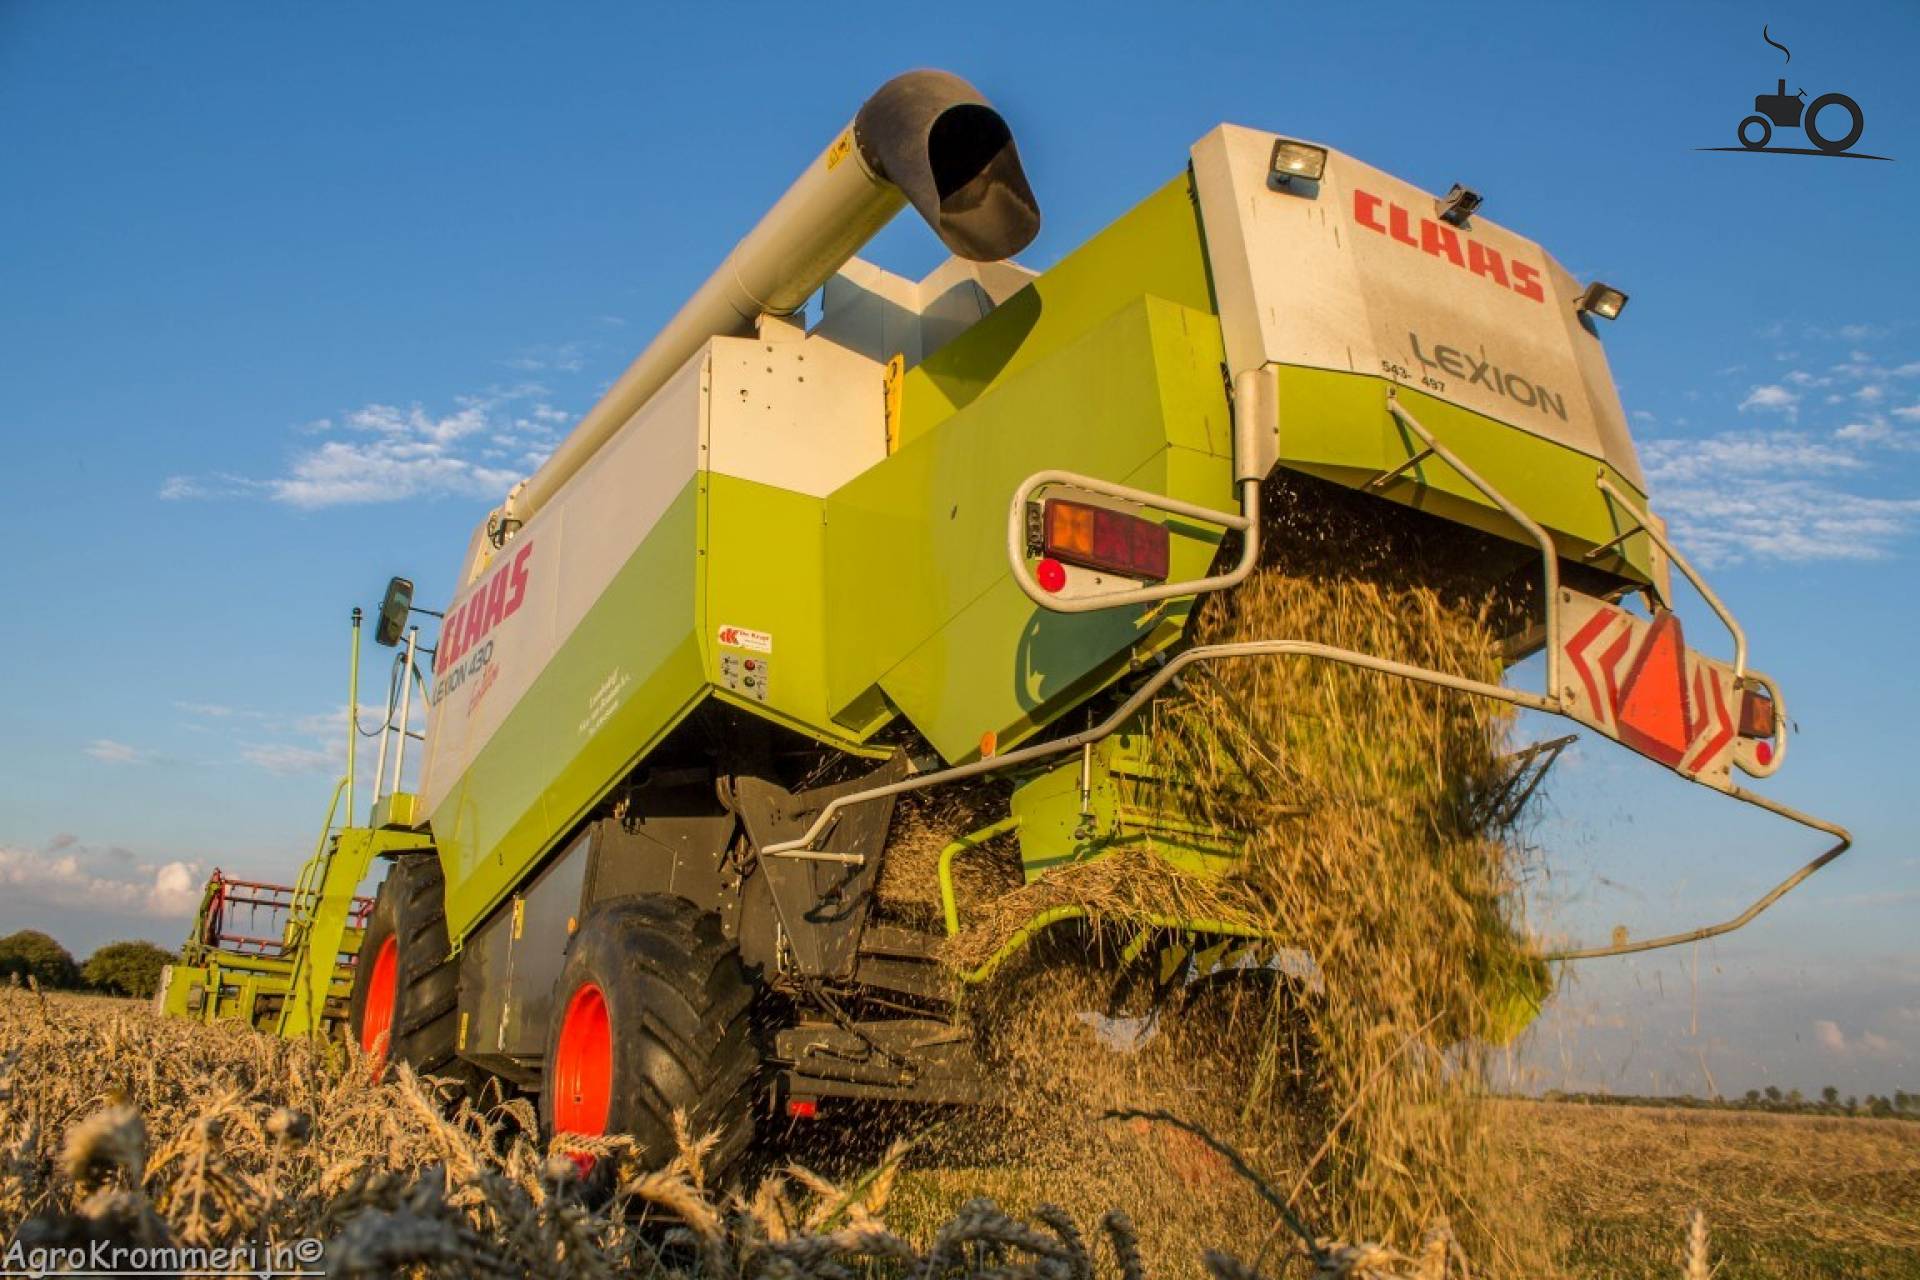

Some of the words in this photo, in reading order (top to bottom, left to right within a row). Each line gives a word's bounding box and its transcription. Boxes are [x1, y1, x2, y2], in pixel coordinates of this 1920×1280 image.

[1354, 189, 1545, 304] CLAAS
[1409, 332, 1568, 422] LEXION
[437, 540, 533, 677] CLAAS
[467, 639, 494, 679] 430
